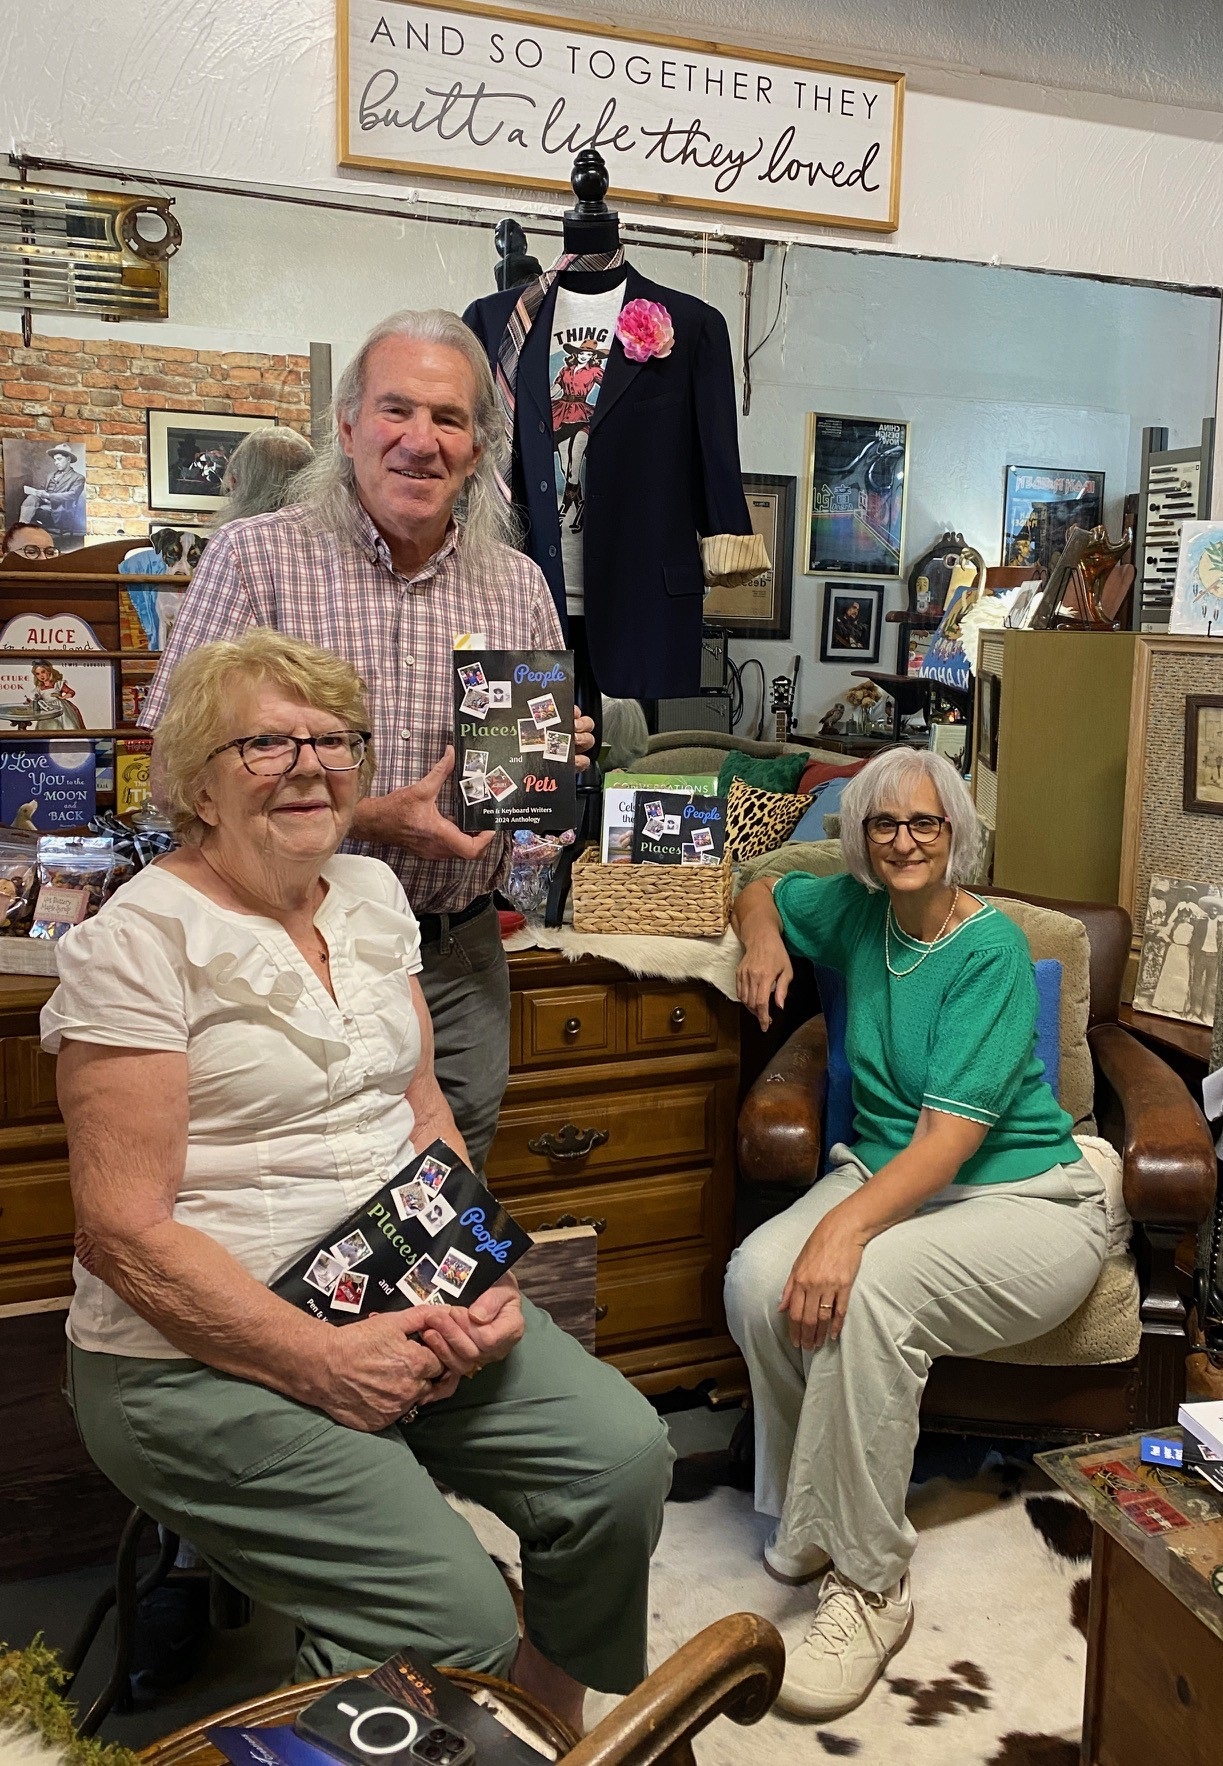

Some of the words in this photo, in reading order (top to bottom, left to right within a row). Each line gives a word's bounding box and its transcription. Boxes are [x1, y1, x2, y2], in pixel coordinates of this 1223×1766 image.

[370, 16, 465, 56] AND
[489, 33, 543, 69] SO
[567, 45, 773, 105] TOGETHER
[793, 81, 880, 121] THEY
[359, 69, 536, 147] built
[507, 124, 529, 146] a
[541, 97, 636, 154] life
[637, 118, 764, 193] they
[757, 125, 881, 193] loved
[553, 326, 609, 345] THING
[27, 628, 76, 644] ALICE
[513, 663, 567, 689] People
[460, 722, 518, 737] Places
[0, 751, 8, 770] I
[509, 755, 523, 763] and
[74, 778, 84, 786] the
[523, 774, 558, 793] Pets
[44, 791, 87, 801] MOON
[129, 788, 152, 802] Th
[64, 801, 77, 809] and
[501, 807, 530, 816] Keyboard
[530, 806, 553, 814] Writers
[48, 810, 84, 821] BACK
[511, 815, 541, 824] Anthology
[683, 805, 721, 824] People
[641, 842, 682, 855] Places
[367, 1202, 417, 1266] Places
[459, 1207, 513, 1264] People
[378, 1278, 395, 1296] and
[306, 1298, 319, 1313] Pen
[316, 1311, 324, 1319] &
